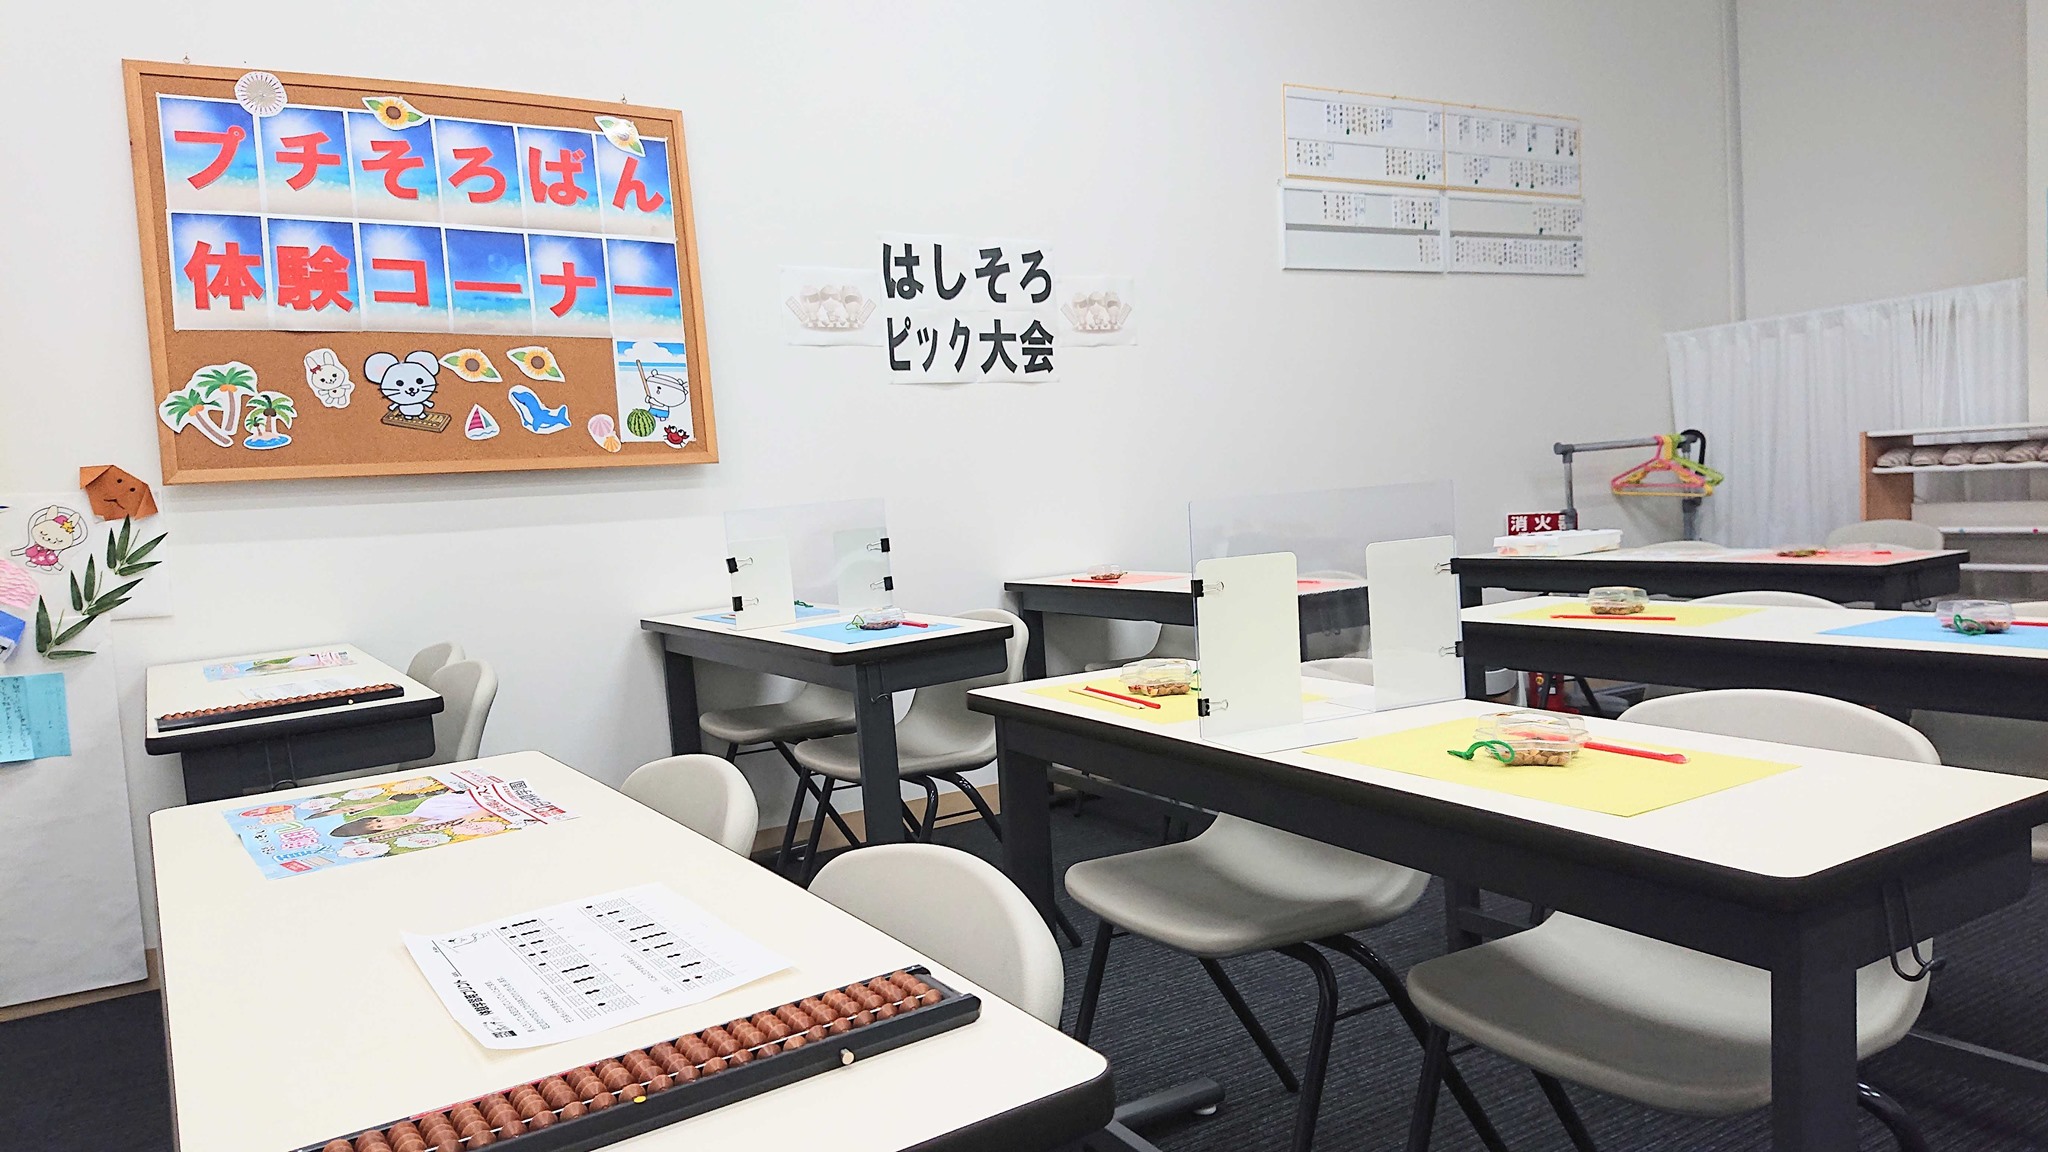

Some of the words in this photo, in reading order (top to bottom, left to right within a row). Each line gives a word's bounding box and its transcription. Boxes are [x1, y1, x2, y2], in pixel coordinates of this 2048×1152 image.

[174, 124, 665, 213] プチそろばん
[184, 240, 674, 318] 体験コーナー
[883, 242, 1053, 303] はしそろ
[887, 316, 1055, 374] ピック大会
